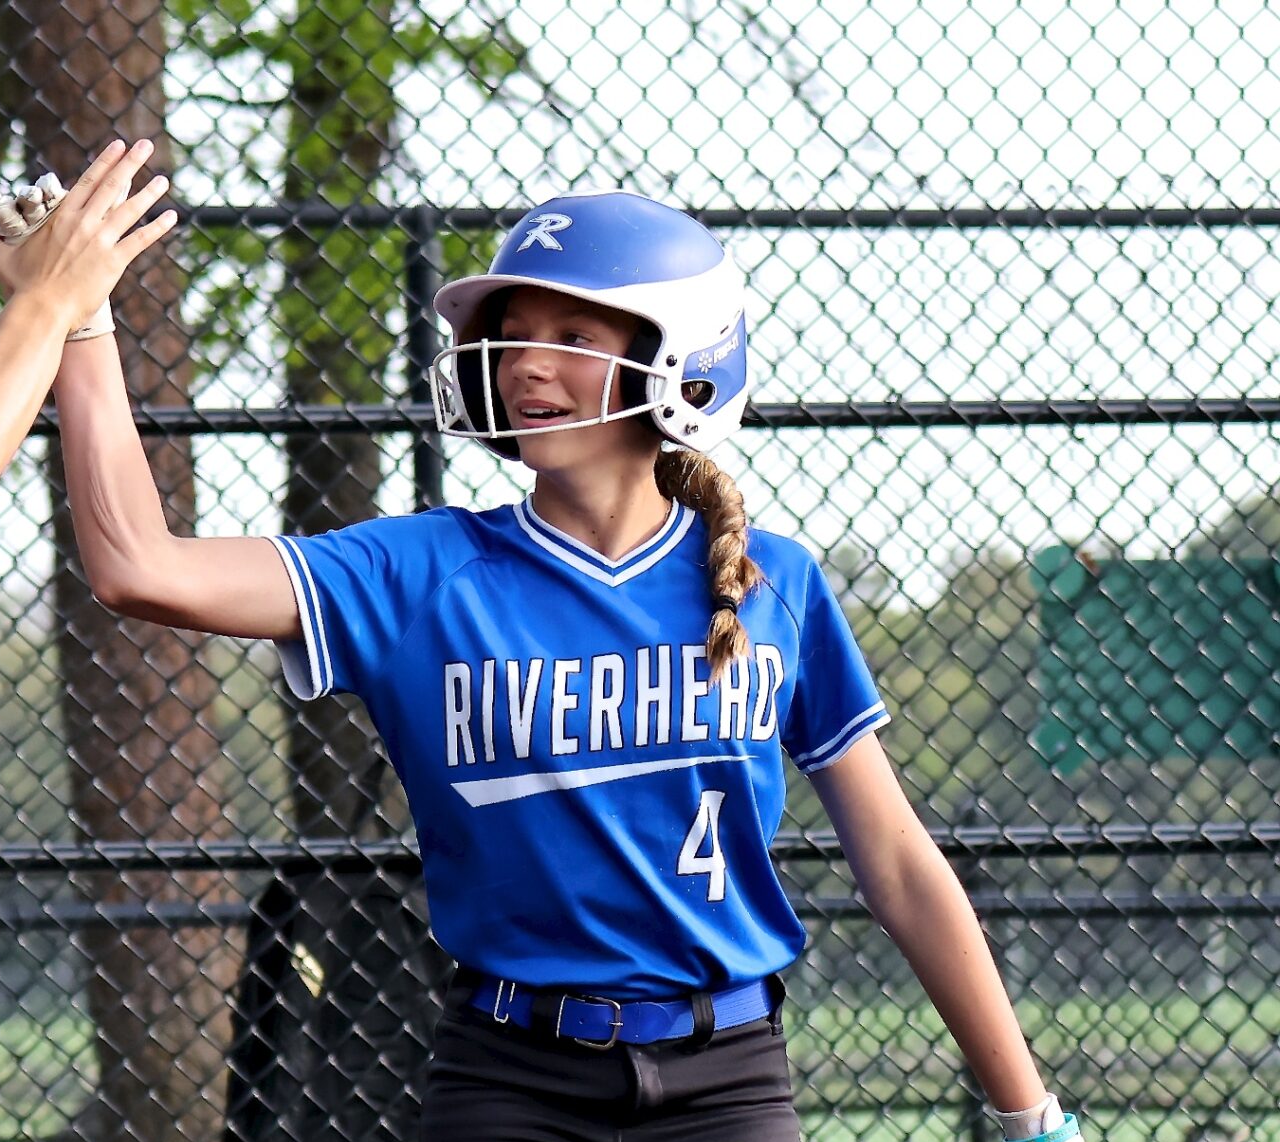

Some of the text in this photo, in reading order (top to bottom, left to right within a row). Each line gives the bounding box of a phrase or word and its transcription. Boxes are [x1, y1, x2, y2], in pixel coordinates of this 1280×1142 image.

[516, 212, 573, 253] R
[444, 643, 785, 767] RIVERHEAD
[676, 789, 728, 902] 4
